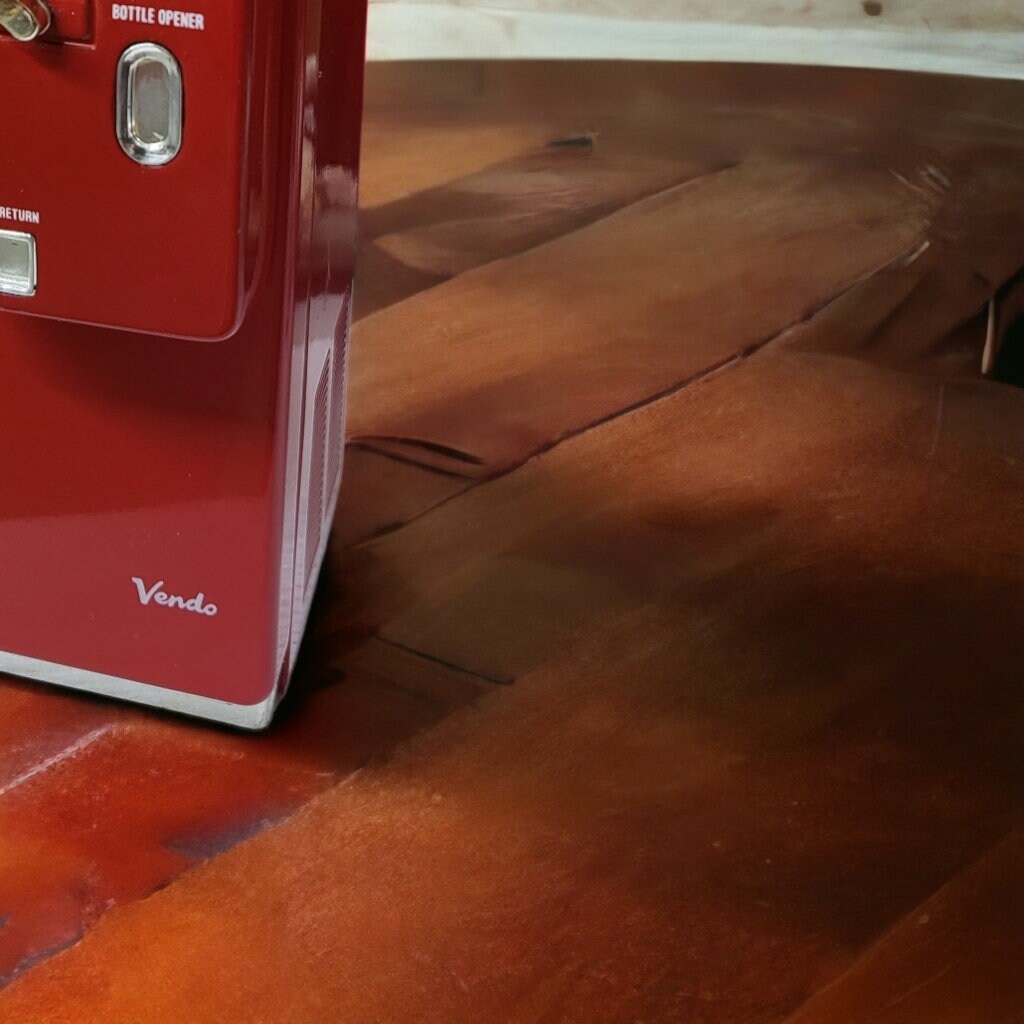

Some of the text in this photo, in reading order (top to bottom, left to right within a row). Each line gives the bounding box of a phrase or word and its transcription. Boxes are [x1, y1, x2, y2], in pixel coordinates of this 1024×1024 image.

[112, 4, 205, 30] BOTTLE OPENER
[0, 206, 40, 224] RETURN
[131, 576, 218, 616] Vendo
